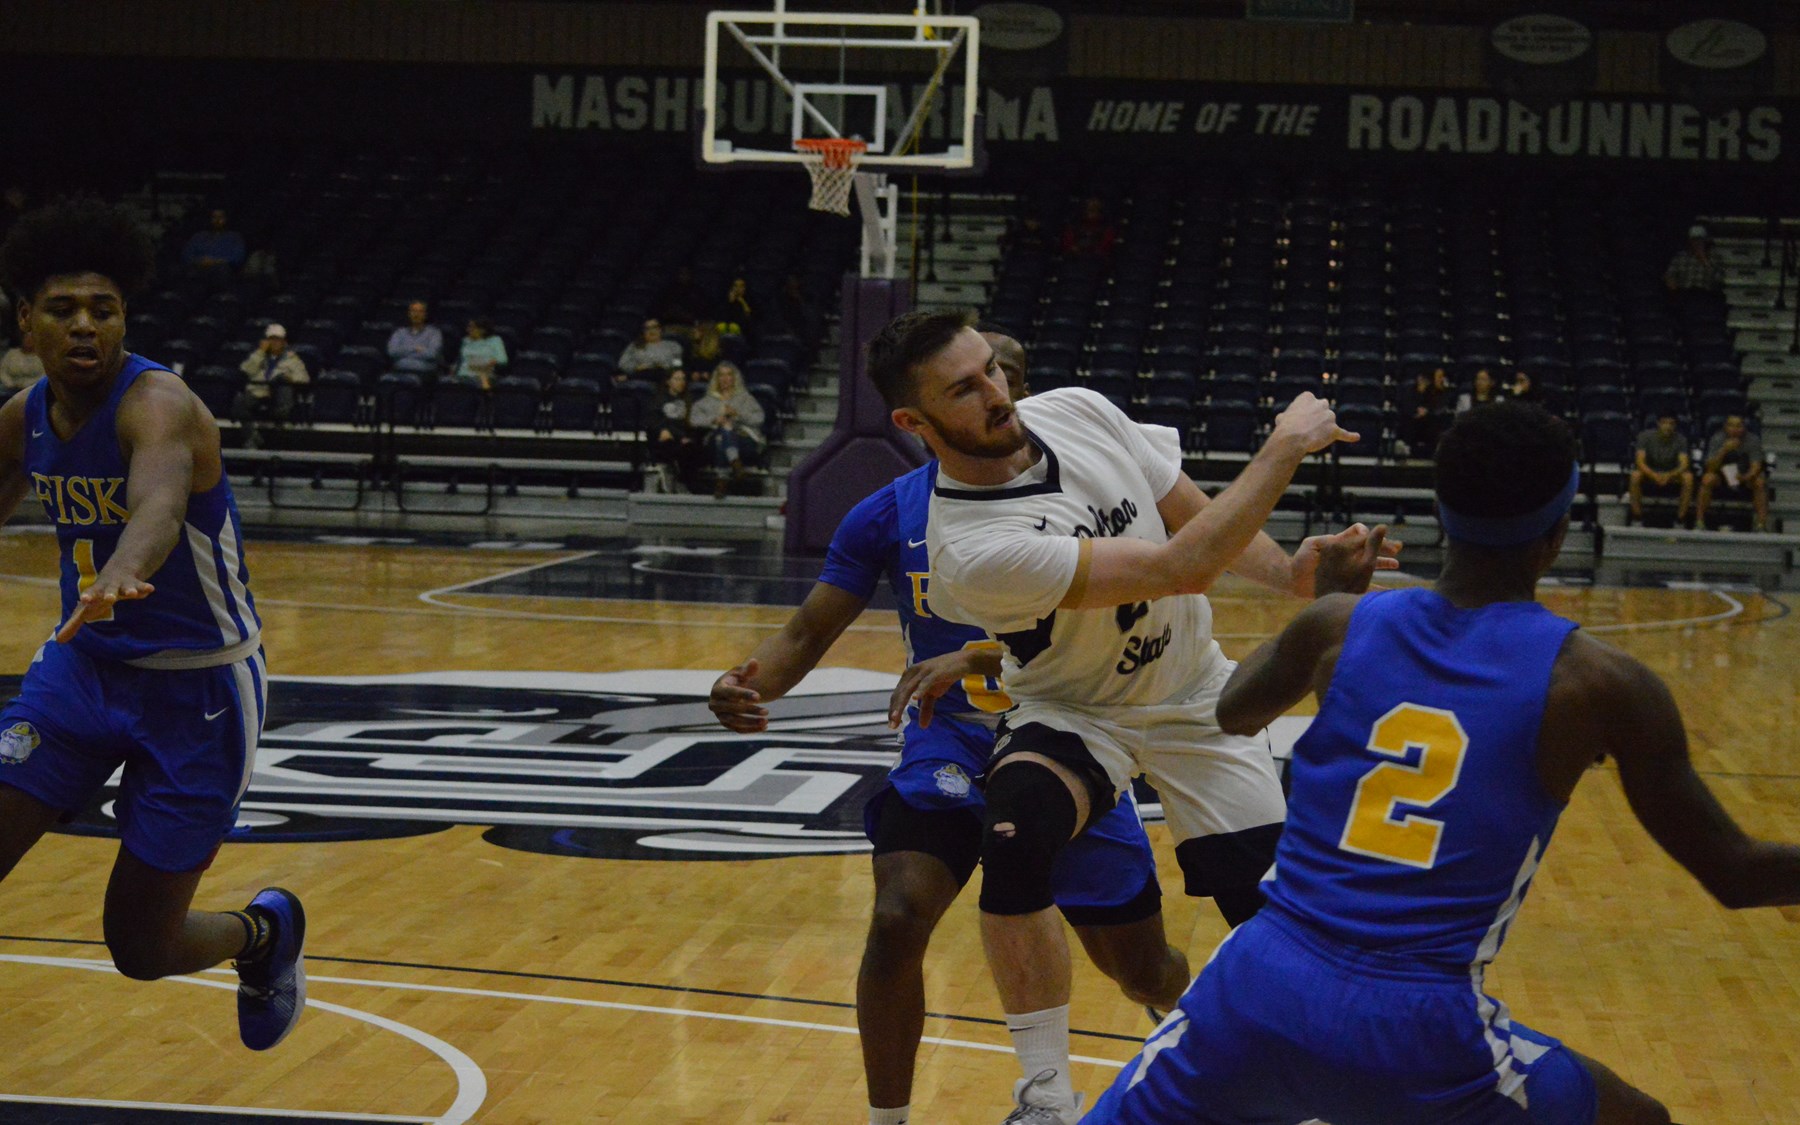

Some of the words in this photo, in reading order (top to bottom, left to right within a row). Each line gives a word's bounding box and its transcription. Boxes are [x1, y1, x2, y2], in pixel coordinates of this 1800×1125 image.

[1087, 99, 1185, 133] HOME
[1194, 102, 1242, 134] OF
[1252, 103, 1321, 136] THE
[1348, 94, 1783, 162] ROADRUNNERS
[31, 471, 131, 525] FISK
[1338, 702, 1470, 869] 2
